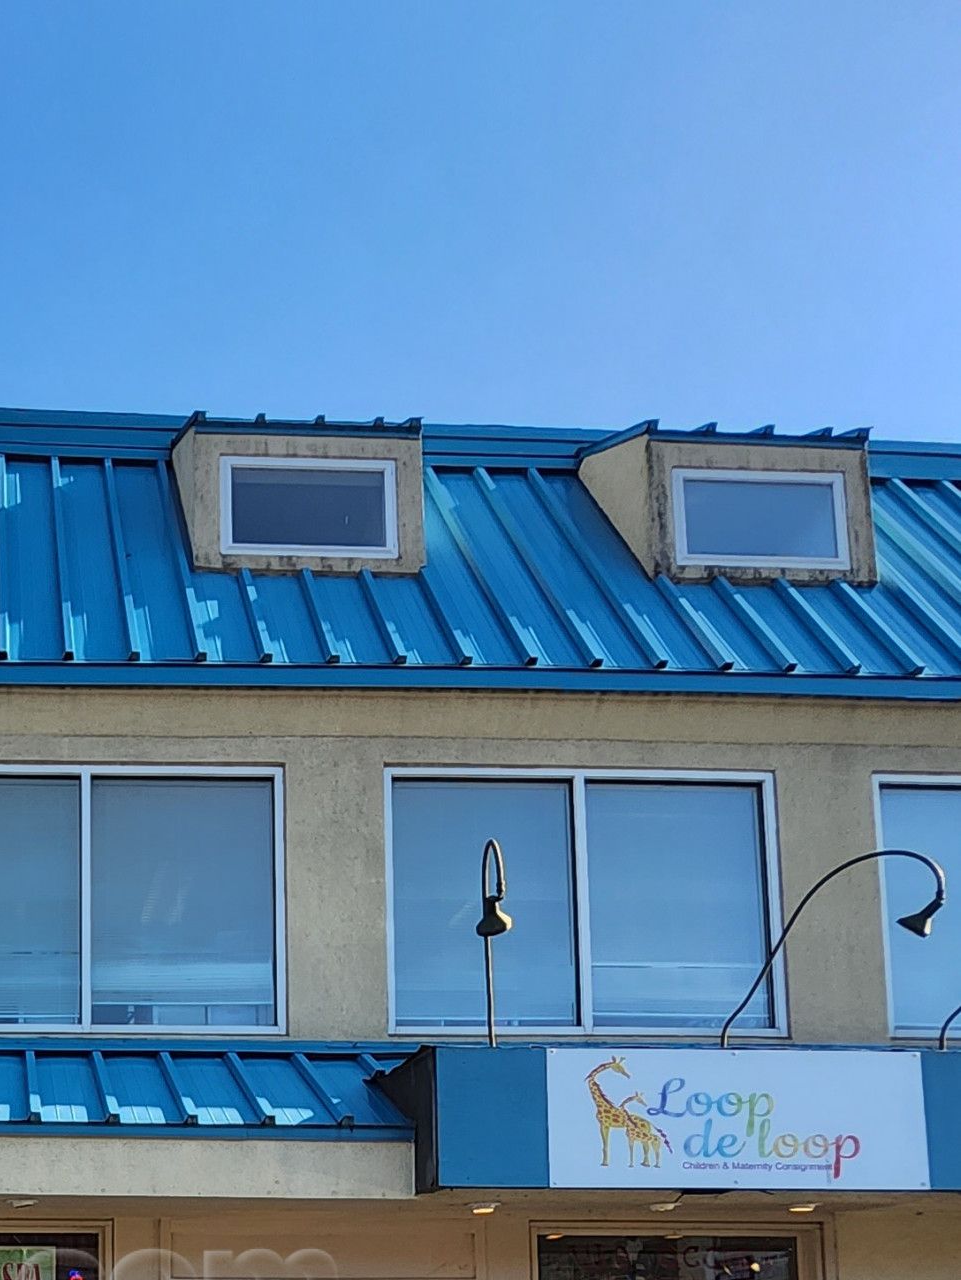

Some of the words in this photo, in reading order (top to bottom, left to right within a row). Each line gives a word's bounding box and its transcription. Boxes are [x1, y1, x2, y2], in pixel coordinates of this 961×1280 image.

[647, 1077, 774, 1137] Loop
[682, 1161, 720, 1170] Children
[723, 1161, 730, 1170] &
[732, 1161, 773, 1172] Maternity
[683, 1118, 746, 1159] de
[758, 1118, 861, 1179] loop
